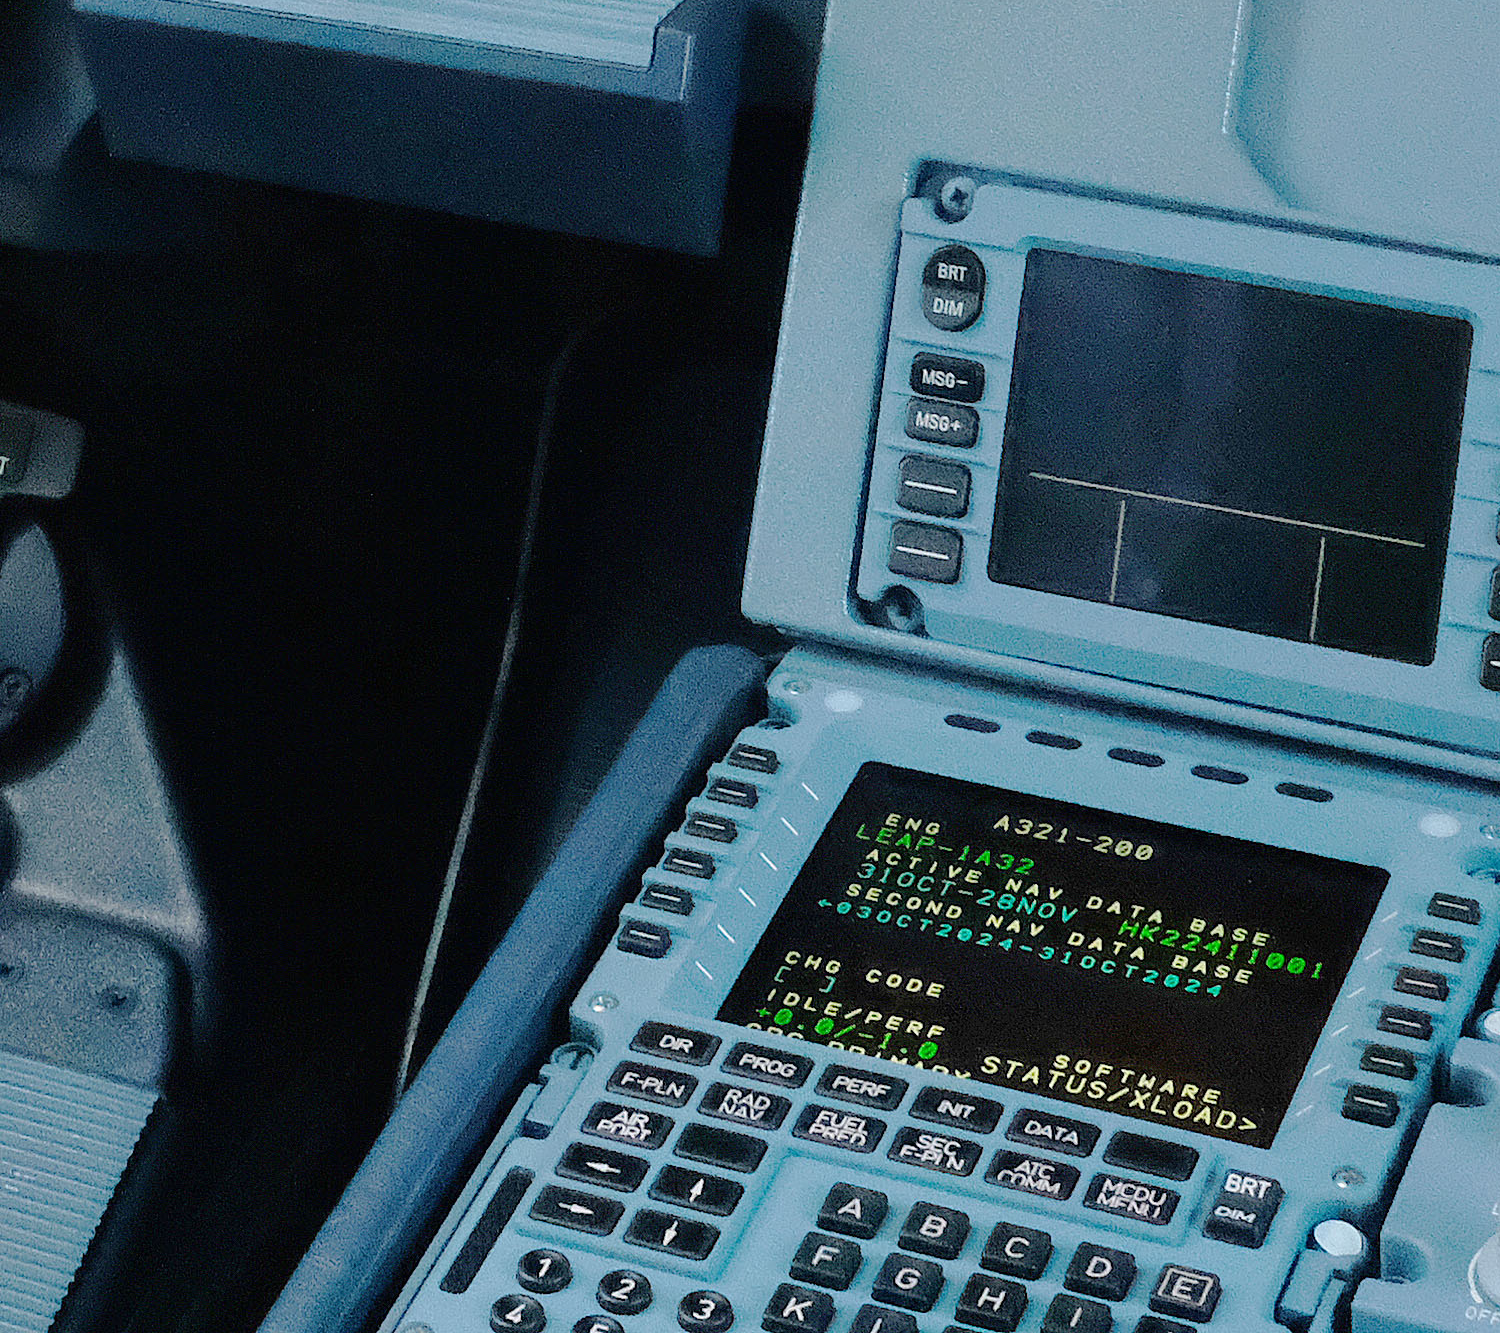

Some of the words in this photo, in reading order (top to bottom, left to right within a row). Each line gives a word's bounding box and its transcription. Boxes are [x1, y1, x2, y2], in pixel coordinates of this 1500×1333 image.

[885, 813, 940, 835] ENG
[993, 814, 1154, 861] A321-200
[865, 849, 982, 883] ACTIVE
[1005, 878, 1063, 900] NAV
[1086, 896, 1163, 923] DATA
[1189, 918, 1272, 946] BASE
[846, 884, 962, 919] SECOND
[986, 914, 1044, 936] NAV
[1067, 932, 1144, 960] DATA
[1171, 955, 1253, 984] BASE
[767, 989, 945, 1038] IDLE/PERF
[659, 1035, 693, 1054] DIR
[739, 1053, 797, 1078] PROG
[832, 1076, 892, 1098] PERF
[1053, 1055, 1221, 1105] SOFTWARE
